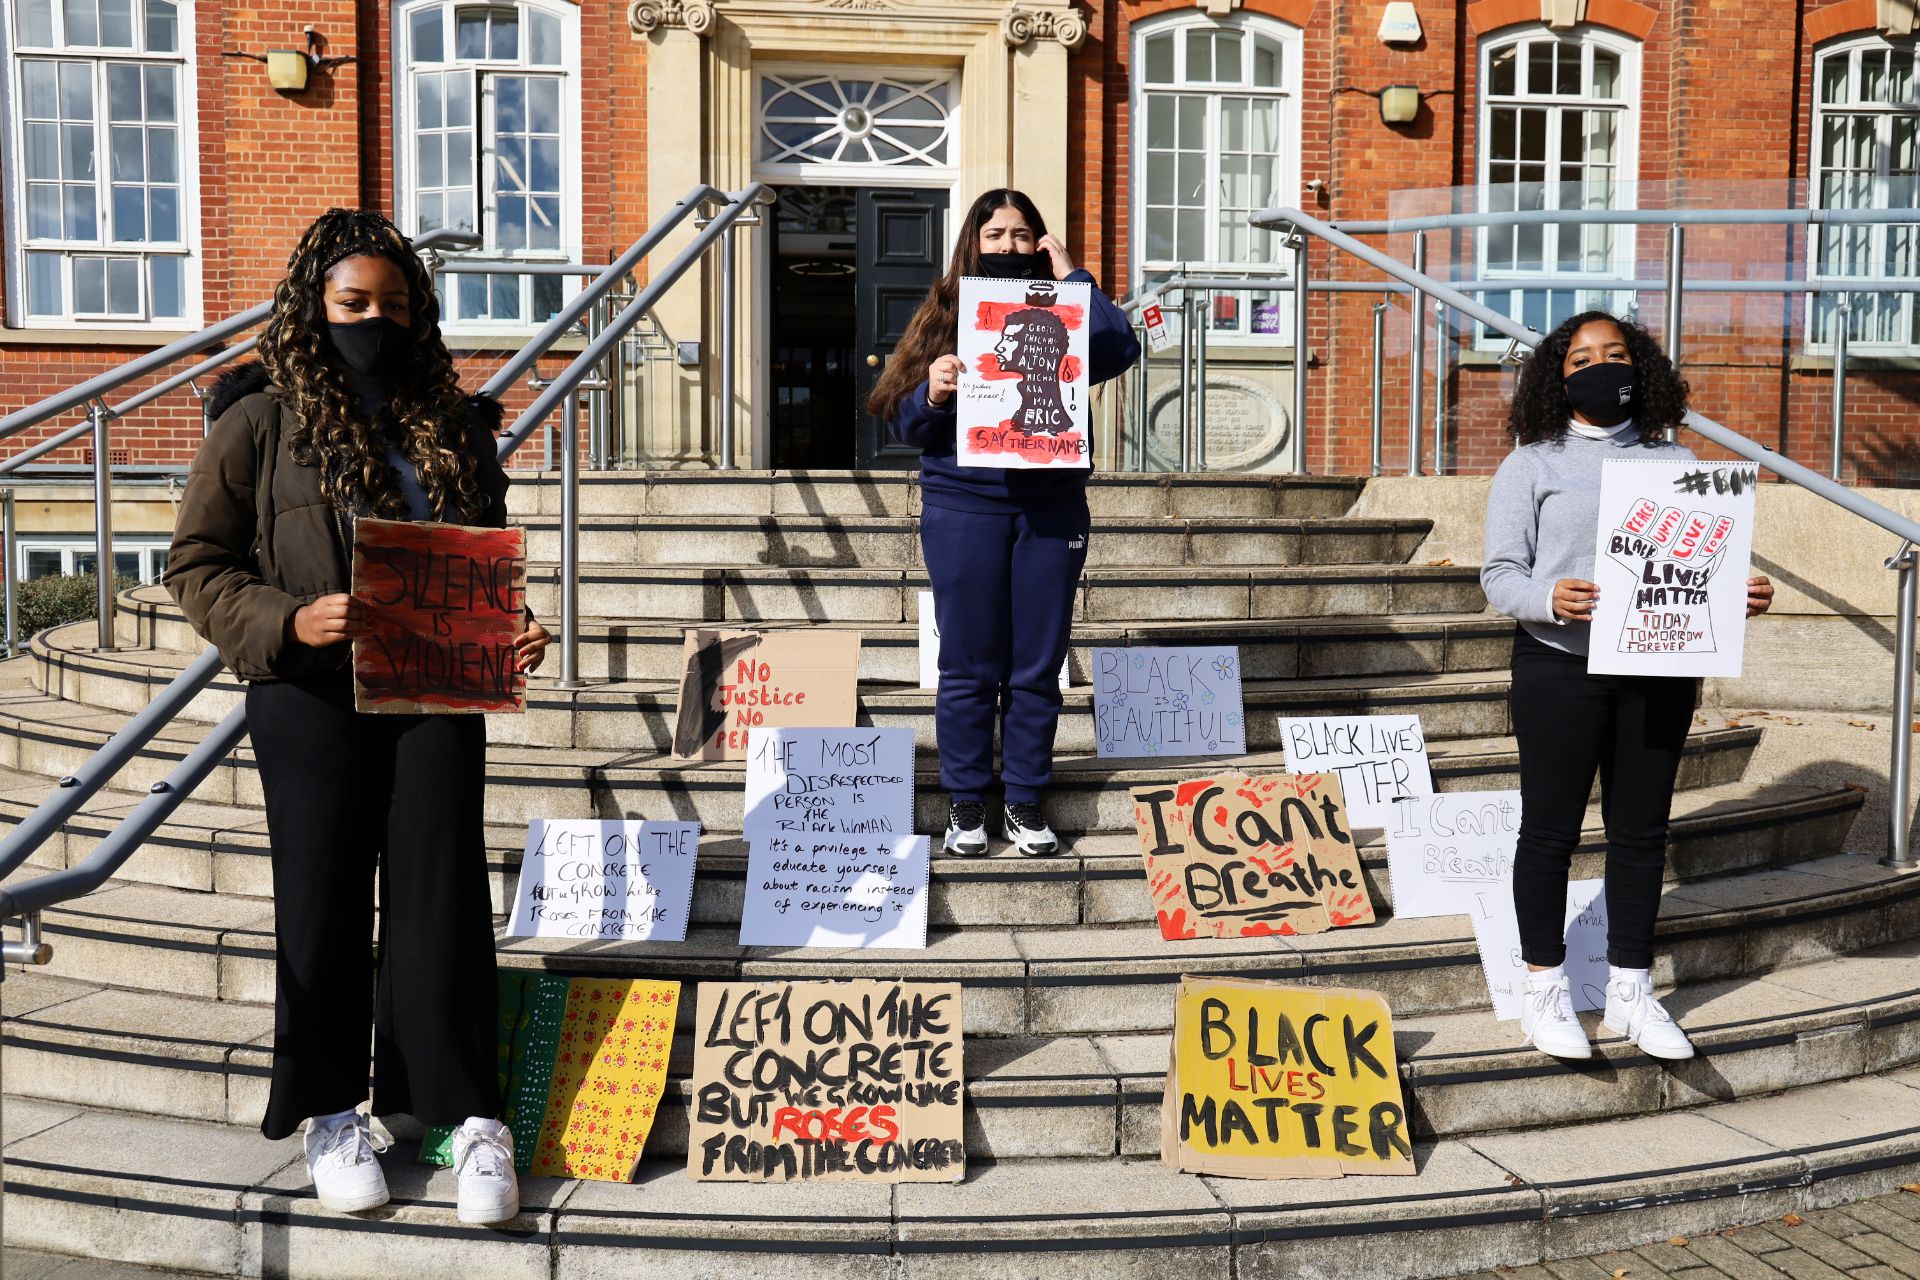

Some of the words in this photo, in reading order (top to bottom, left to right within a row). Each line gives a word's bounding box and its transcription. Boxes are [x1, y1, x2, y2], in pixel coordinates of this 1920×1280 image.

[1018, 355, 1057, 372] ALTON
[1024, 408, 1061, 425] ERIC
[976, 429, 1008, 449] SAY
[1010, 438, 1046, 451] THEIR
[1048, 439, 1088, 456] NAMES
[1625, 501, 1656, 533] PEACE
[1653, 510, 1682, 543] UNITY
[1672, 518, 1707, 558] LOVE
[1704, 518, 1731, 553] POWER
[372, 547, 526, 614] SILENCE
[1642, 560, 1710, 589] LIVES
[1636, 587, 1708, 609] MATTER
[432, 612, 453, 637] IS
[1625, 627, 1704, 642] TOMORROW
[1638, 609, 1691, 631] TODAY
[1627, 641, 1686, 653] FOREVER
[373, 634, 525, 697] VIOLENCE
[737, 658, 771, 684] NO
[1100, 652, 1214, 696] BLACK
[718, 684, 806, 707] Justice
[1154, 696, 1170, 706] IS
[736, 707, 764, 728] NO
[1098, 704, 1236, 745] BEAUTIFUL
[756, 736, 798, 774] THE
[821, 735, 881, 769] MOST
[1290, 722, 1364, 760] BLACK
[1370, 723, 1423, 755] LIVES
[1298, 757, 1413, 808] TTER
[774, 793, 835, 810] PERSON
[853, 792, 865, 804] IS
[803, 808, 829, 822] THE
[1133, 789, 1184, 856] I
[1193, 786, 1351, 855] Can't
[1392, 795, 1422, 838] I
[534, 824, 596, 857] LEFT
[604, 833, 642, 857] ON
[650, 829, 691, 856] THE
[769, 838, 789, 852] It's
[795, 845, 804, 853] a
[812, 841, 868, 861] privilege
[877, 843, 891, 856] to
[557, 860, 651, 882] CONCRETE
[773, 858, 828, 873] educate
[835, 863, 899, 883] yourself
[1184, 852, 1358, 911] Breathe
[570, 881, 617, 905] GROW
[763, 878, 799, 891] about
[806, 882, 853, 894] racism
[867, 883, 915, 895] instead
[588, 908, 632, 922] FROM
[640, 904, 668, 922] THE
[774, 898, 791, 914] of
[801, 900, 883, 922] experiencing
[566, 922, 648, 936] CONCRETE
[704, 985, 793, 1049] LEFT
[803, 994, 874, 1045] ON
[877, 984, 952, 1039] THE
[1200, 997, 1389, 1080] BLACK
[723, 1040, 953, 1091] CONCRETE
[1228, 1057, 1326, 1100] LIVES
[697, 1081, 777, 1130] BUT
[772, 1104, 900, 1147] ROSES
[1180, 1092, 1413, 1161] MATTER
[701, 1131, 798, 1181] FROM
[794, 1137, 855, 1179] THE
